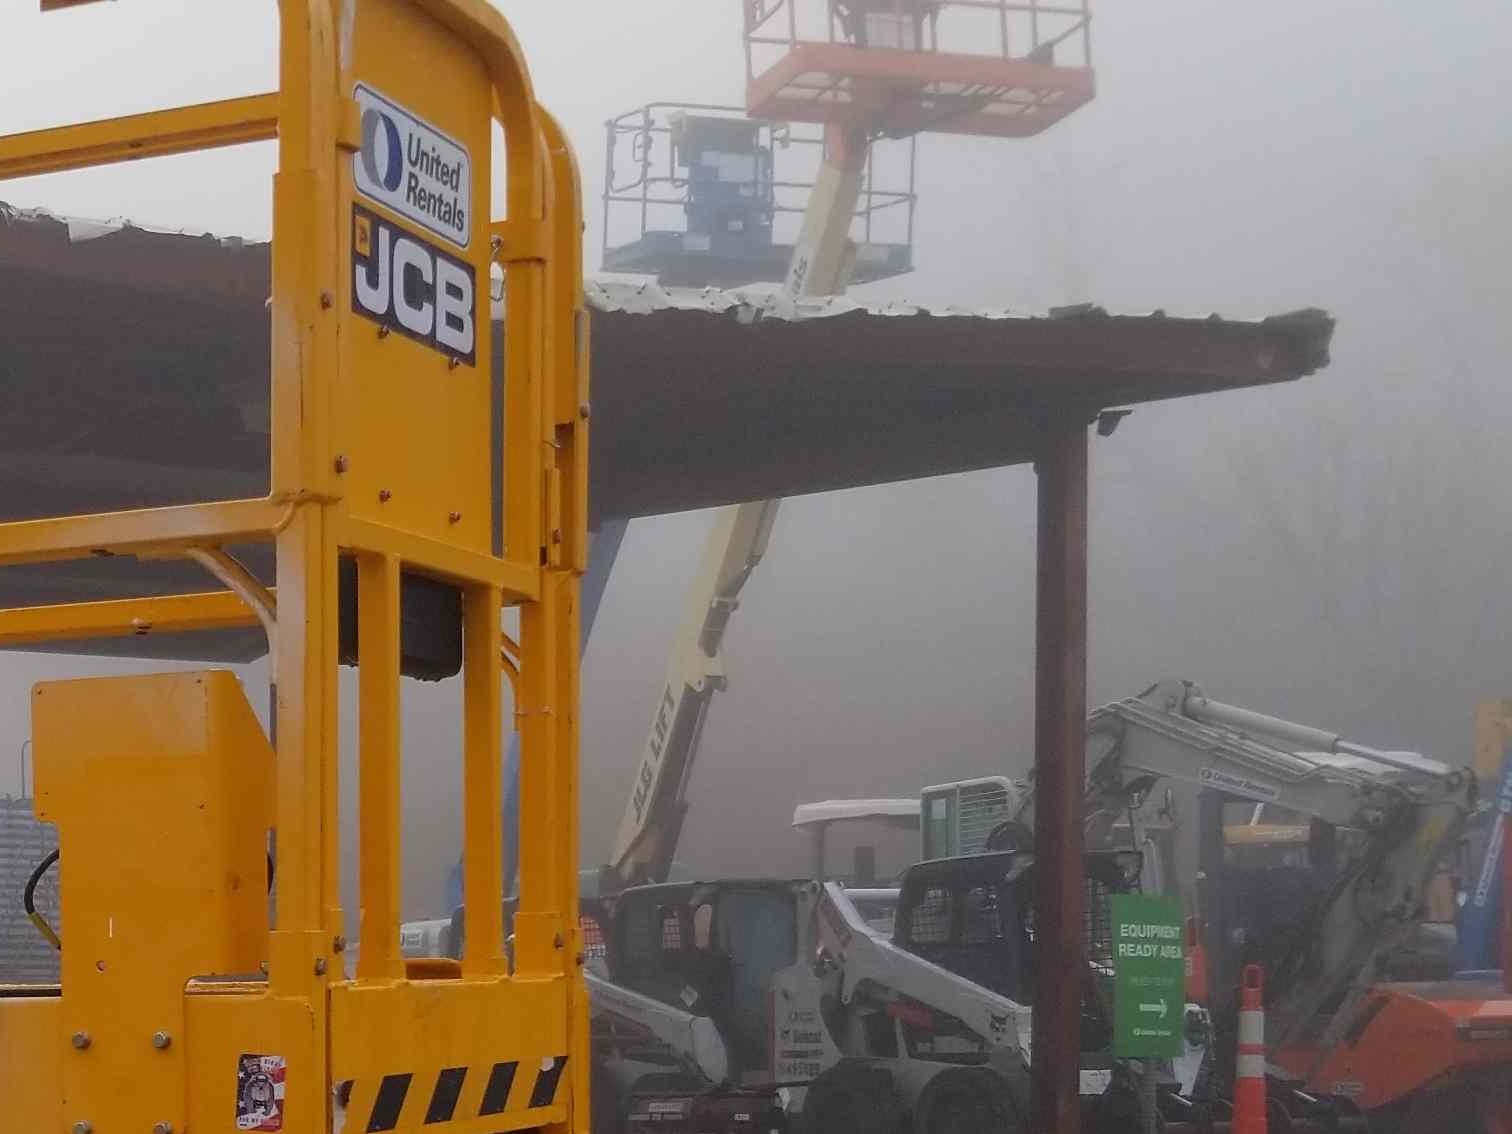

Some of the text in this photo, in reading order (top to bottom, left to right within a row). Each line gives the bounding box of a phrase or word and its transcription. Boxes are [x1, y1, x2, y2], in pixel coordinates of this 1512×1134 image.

[407, 133, 461, 193] United
[405, 174, 465, 233] Rentals
[355, 226, 474, 355] JCB
[650, 682, 675, 761] LIFT
[1118, 943, 1183, 959] READY AREA
[1120, 924, 1180, 939] EQUIPMENT
